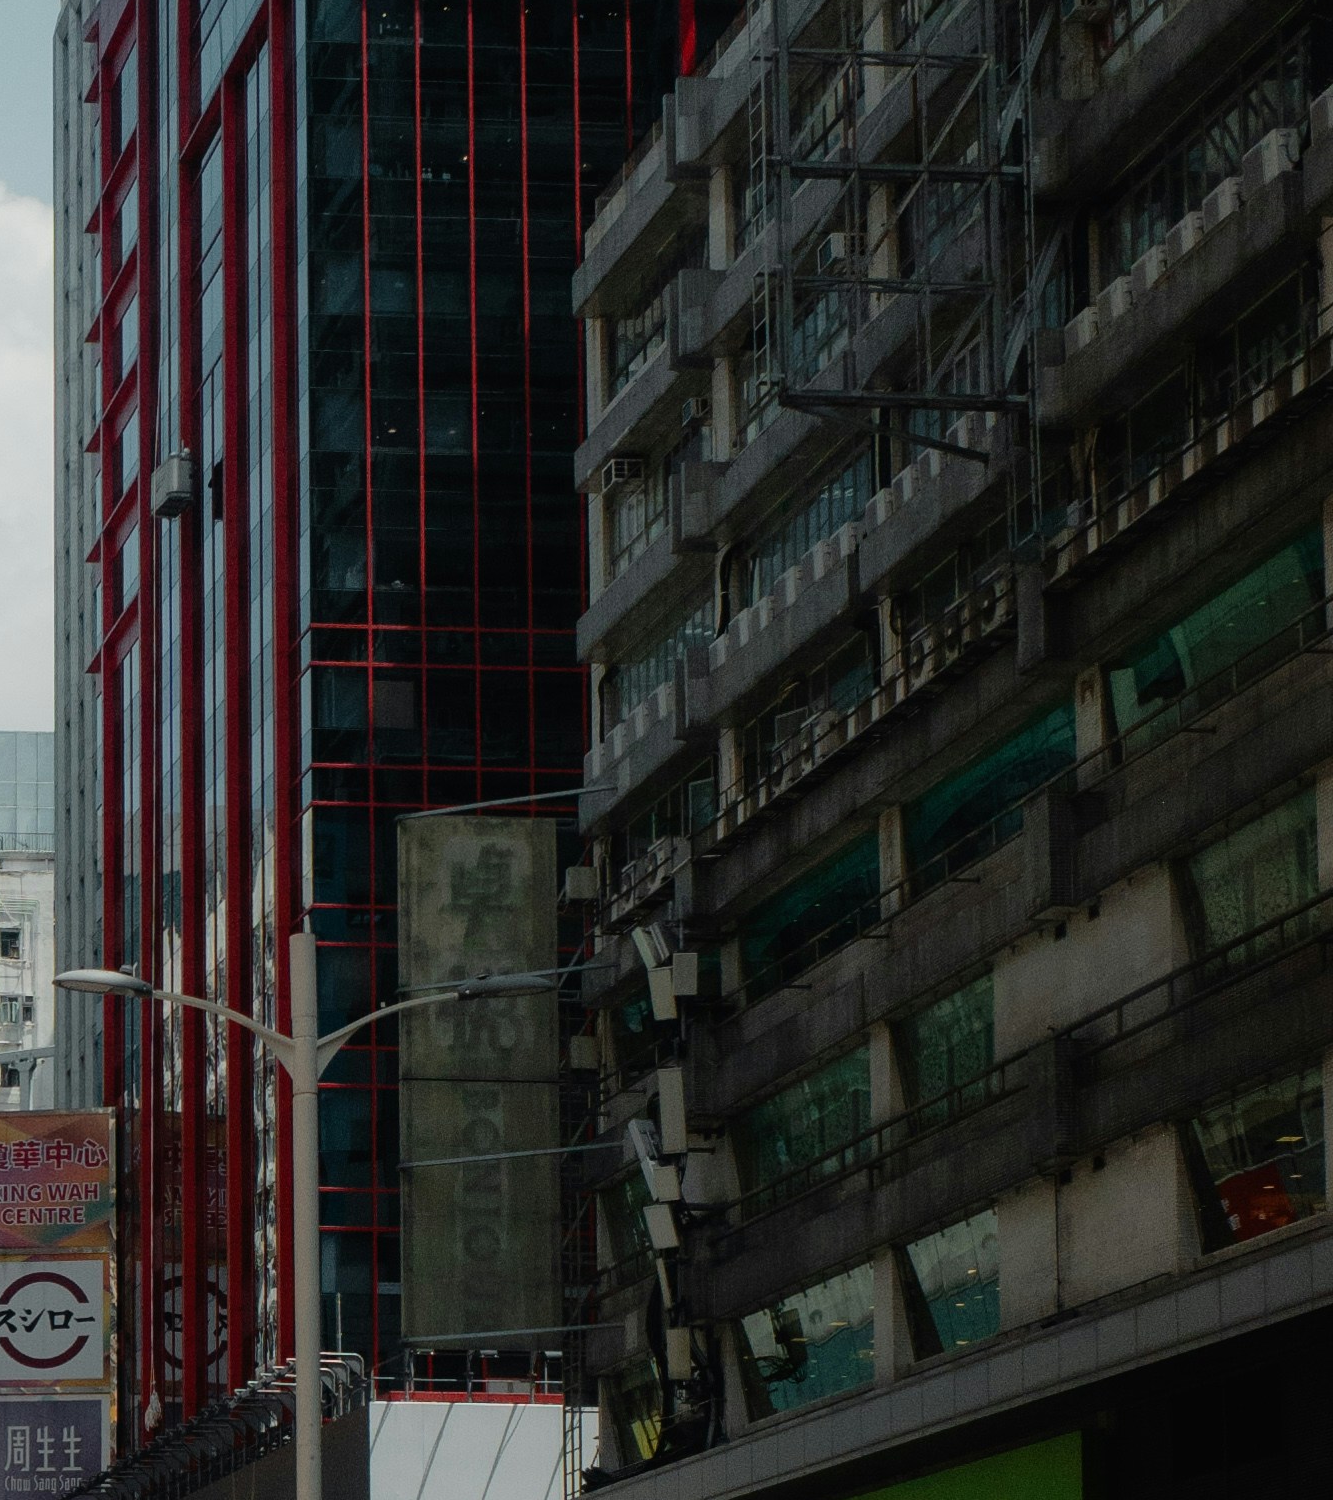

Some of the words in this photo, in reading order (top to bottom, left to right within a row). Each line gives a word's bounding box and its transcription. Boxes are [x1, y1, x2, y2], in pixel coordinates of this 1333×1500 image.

[49, 1182, 99, 1201] WAH
[2, 1205, 85, 1225] CENTRE
[5, 1425, 82, 1472] 周生生
[5, 1474, 31, 1492] Chow
[33, 1474, 57, 1494] Sang
